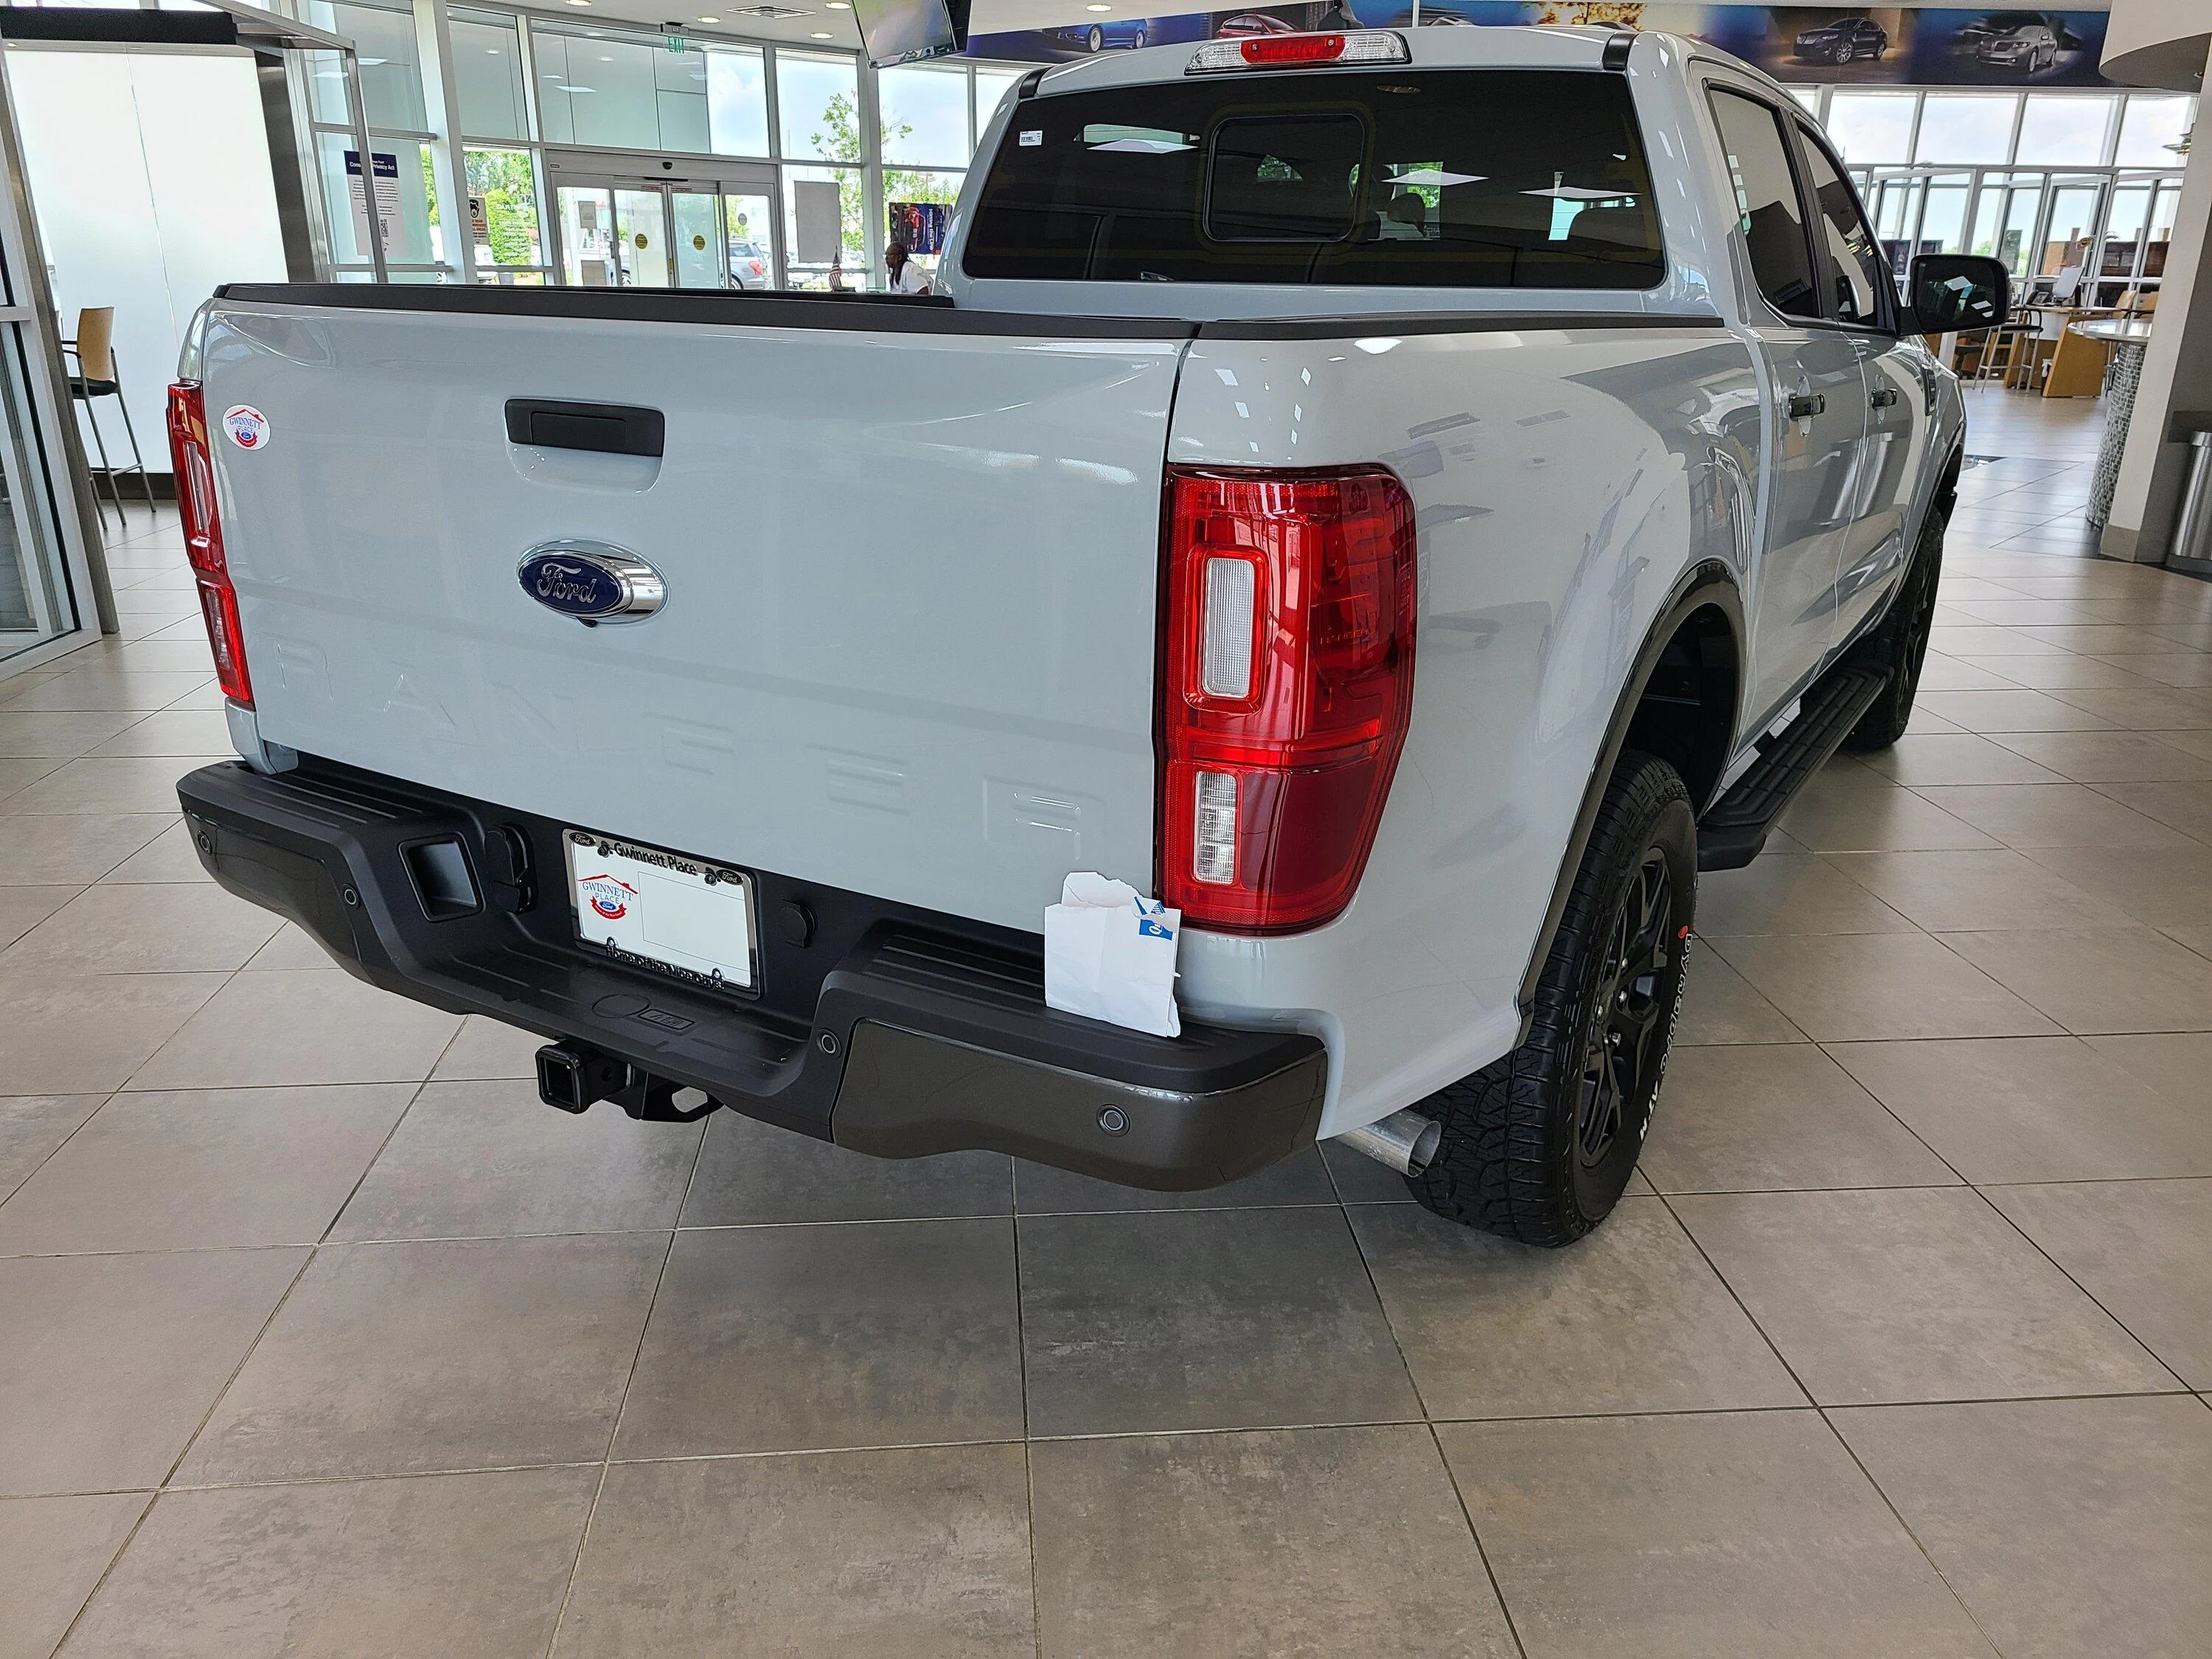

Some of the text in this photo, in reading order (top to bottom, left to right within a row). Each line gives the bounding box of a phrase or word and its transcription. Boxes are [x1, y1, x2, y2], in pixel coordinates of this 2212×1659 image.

[668, 36, 684, 54] EXIT
[229, 417, 261, 429] GWINNETT
[537, 563, 597, 603] Ford
[575, 834, 591, 845] Ford
[613, 843, 697, 876] Gwinnett Place
[722, 872, 738, 883] Ford
[582, 881, 633, 901] GWINNETT
[595, 892, 619, 904] PLACE
[605, 946, 636, 963] Home
[649, 959, 667, 972] the
[669, 964, 692, 981] Nice
